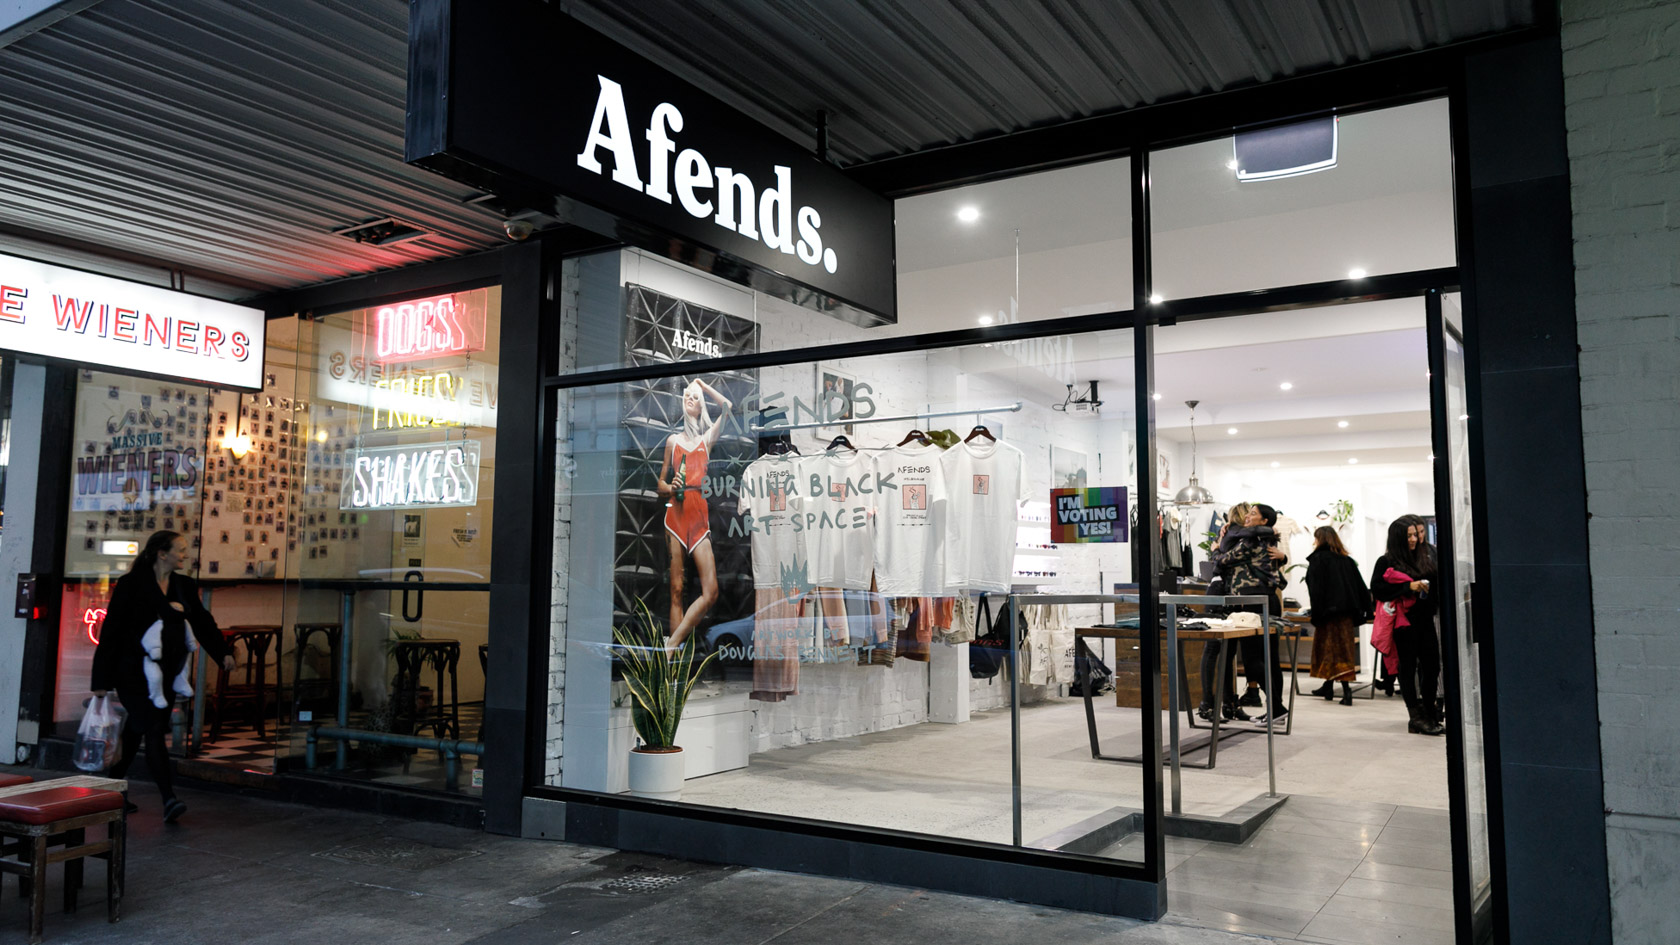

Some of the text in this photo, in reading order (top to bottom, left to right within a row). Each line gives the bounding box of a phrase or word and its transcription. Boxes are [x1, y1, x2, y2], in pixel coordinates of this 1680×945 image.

[577, 74, 838, 274] Afends.
[52, 294, 249, 362] WIENERS
[377, 297, 454, 357] DOGS
[672, 329, 723, 358] Afends.
[719, 382, 876, 435] AFENDS
[112, 432, 163, 450] MASSIVE
[77, 447, 197, 495] WIENERS
[353, 449, 465, 506] SHAKES
[897, 465, 931, 474] AFENDS
[701, 472, 898, 499] BURNING BLACK
[1058, 496, 1081, 510] I'M
[1058, 506, 1118, 523] VOTING
[728, 506, 867, 538] ART SPACE
[1079, 521, 1112, 535] YES!
[718, 644, 786, 662] DOUGLAS
